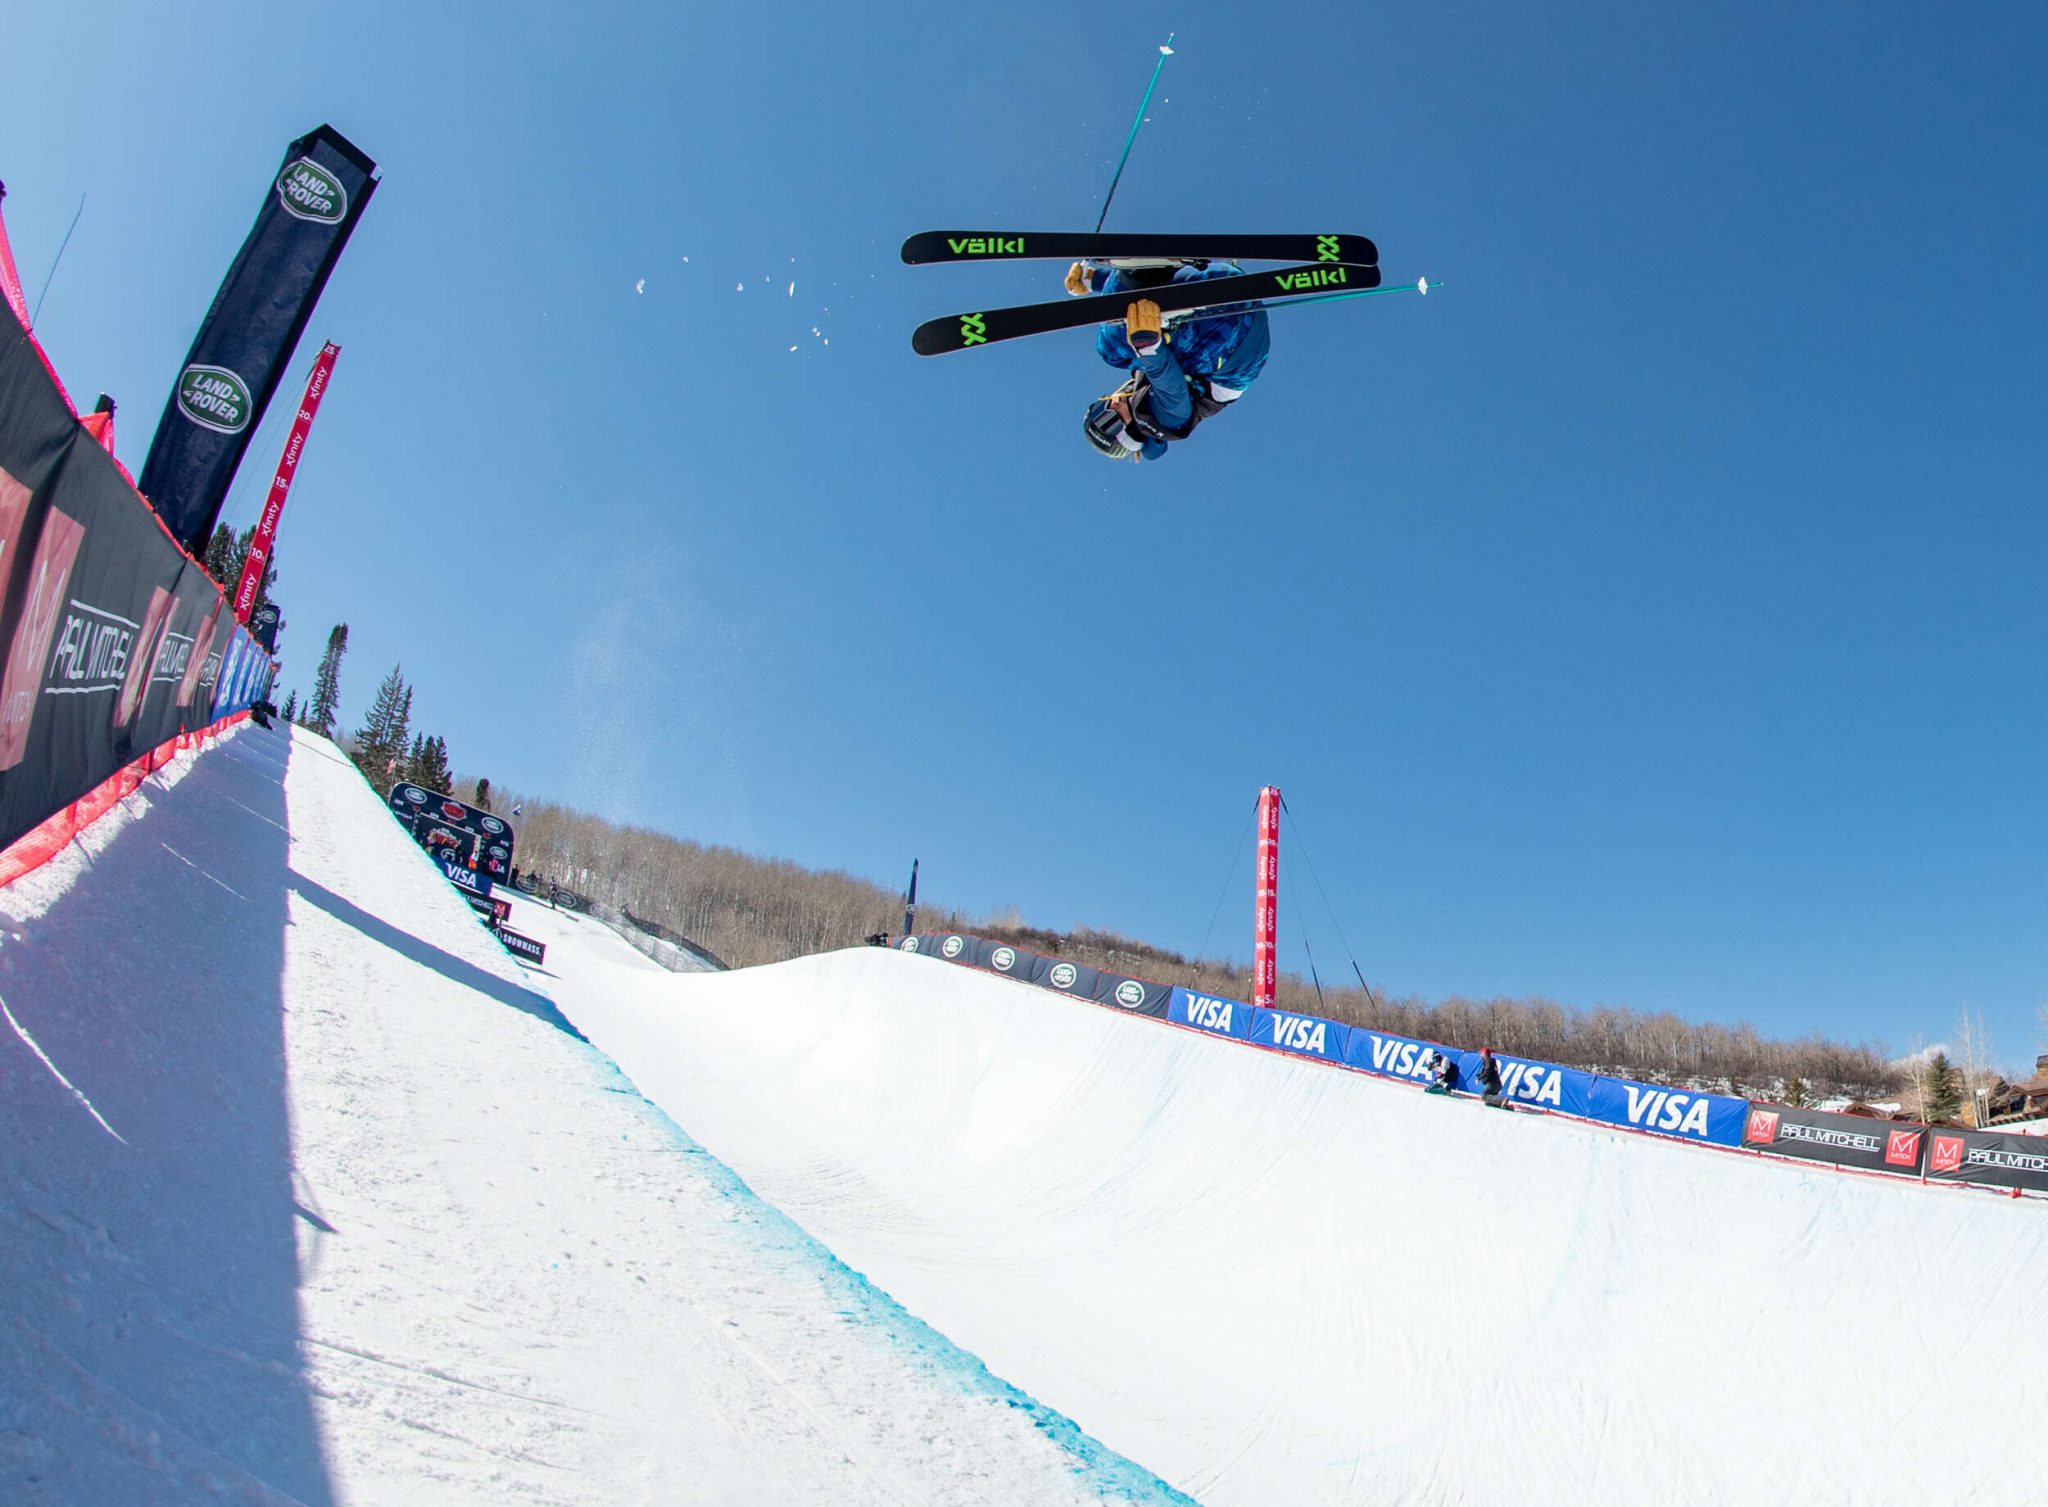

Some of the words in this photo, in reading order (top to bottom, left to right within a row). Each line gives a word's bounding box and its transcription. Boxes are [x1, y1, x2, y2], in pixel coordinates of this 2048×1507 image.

[294, 164, 328, 195] LAND
[286, 180, 332, 214] ROVER
[947, 237, 1024, 254] Völkl
[1275, 267, 1346, 290] Völkl
[192, 374, 233, 399] LAND
[310, 366, 328, 399] xfinity
[188, 390, 239, 423] ROVER
[286, 432, 304, 467] xfinity
[262, 501, 280, 536] xfinity
[240, 573, 257, 610] xfinity
[445, 862, 477, 887] VISA
[503, 934, 540, 956] SNOWMASS
[1186, 993, 1233, 1032] VISA
[1271, 1013, 1327, 1054] VISA
[1369, 1035, 1434, 1081] VISA
[1623, 1085, 1709, 1136] VISA
[1781, 1125, 1814, 1139] PAUL
[1816, 1131, 1880, 1150] MITCHELL
[1968, 1150, 2005, 1166] PAUL
